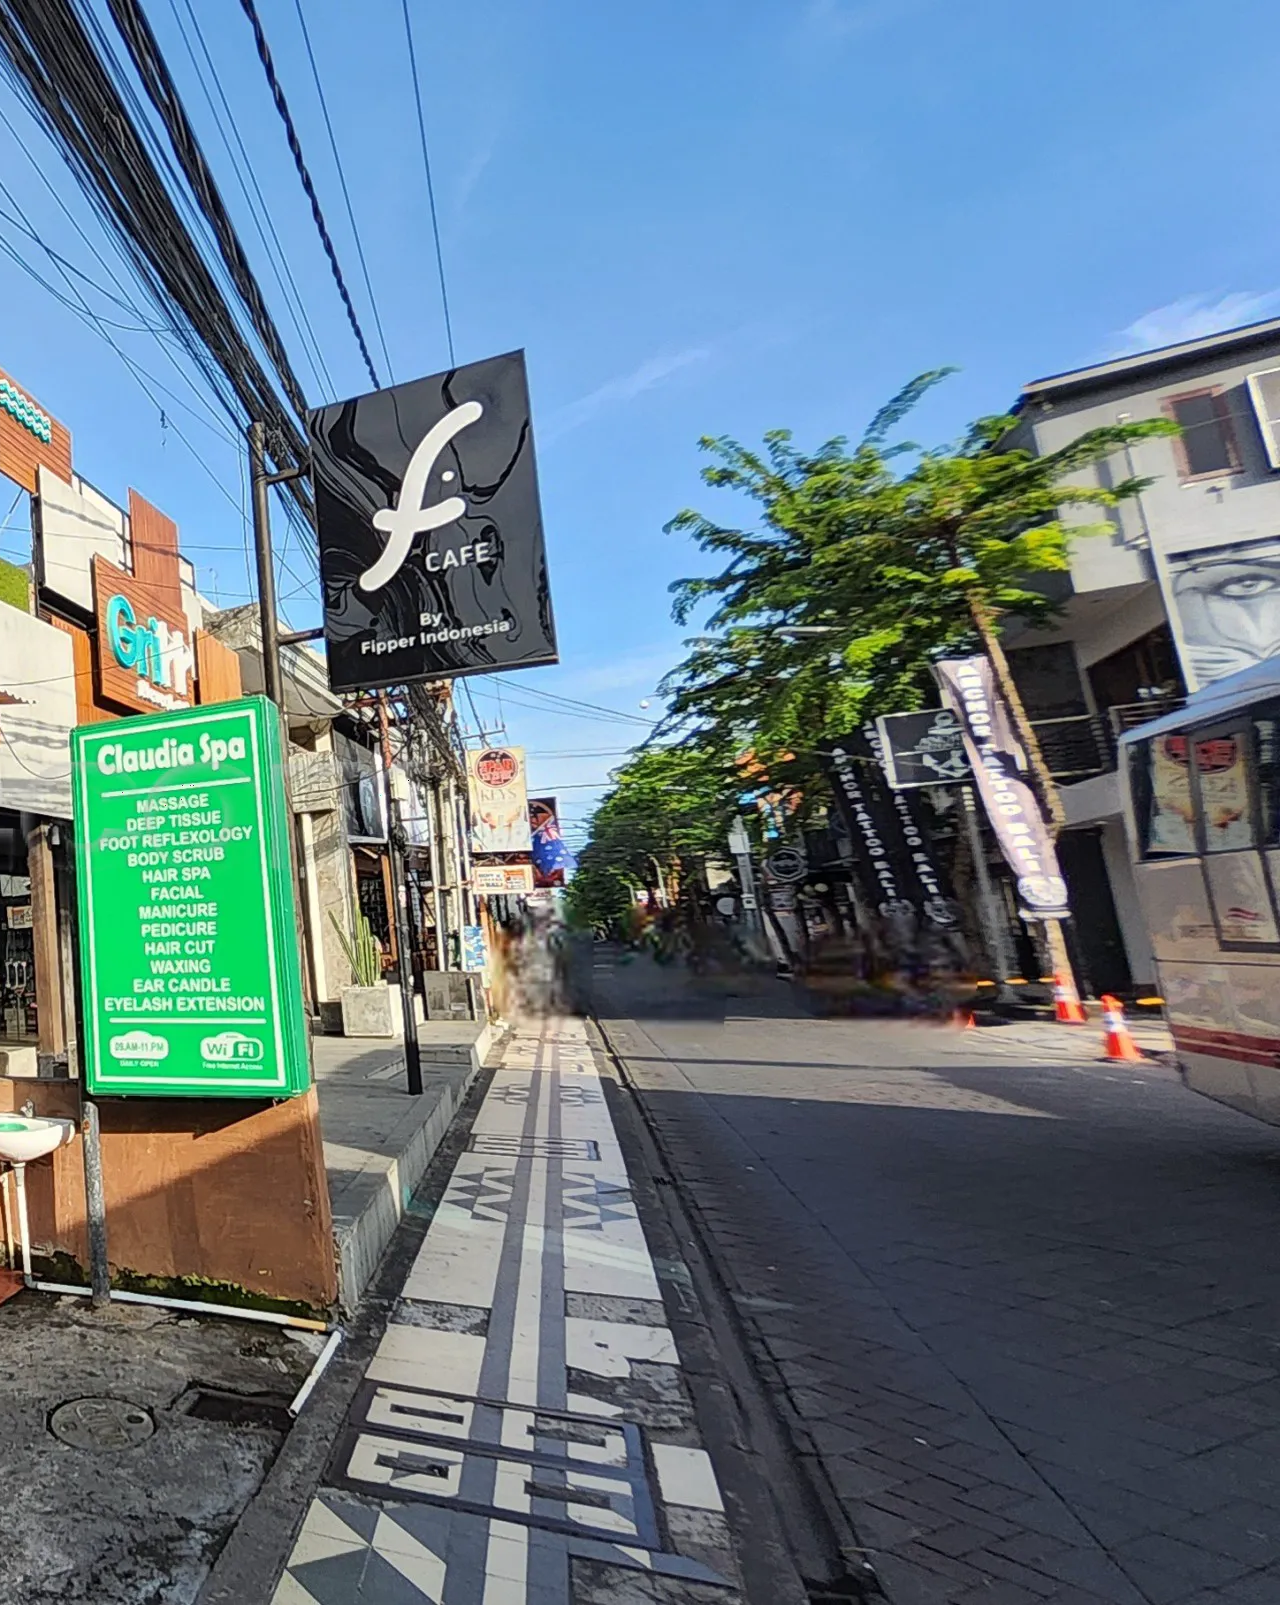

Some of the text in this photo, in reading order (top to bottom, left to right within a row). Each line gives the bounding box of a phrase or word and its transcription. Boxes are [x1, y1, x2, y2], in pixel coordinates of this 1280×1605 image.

[425, 542, 491, 572] CAFE
[419, 612, 443, 628] By
[361, 619, 510, 655] Fipper Indonesia
[97, 733, 246, 775] Claudia Spa
[136, 793, 209, 813] MASSAGE
[126, 811, 222, 832] DEEP TISSUE
[99, 826, 253, 851] FOOT REFLEXOLOGY
[127, 847, 225, 868] BODY SCRUB
[142, 867, 211, 884] HAIR SPA
[150, 886, 204, 901] FACIAL
[138, 903, 218, 919] MANICURE
[141, 921, 218, 938] PEDICURE
[144, 940, 216, 955] HAIR CUT
[150, 959, 211, 974] WAXING
[133, 978, 231, 994] EAR CANDLE
[104, 996, 265, 1012] EYELASH EXTENSION
[206, 1042, 254, 1058] Wi Fi
